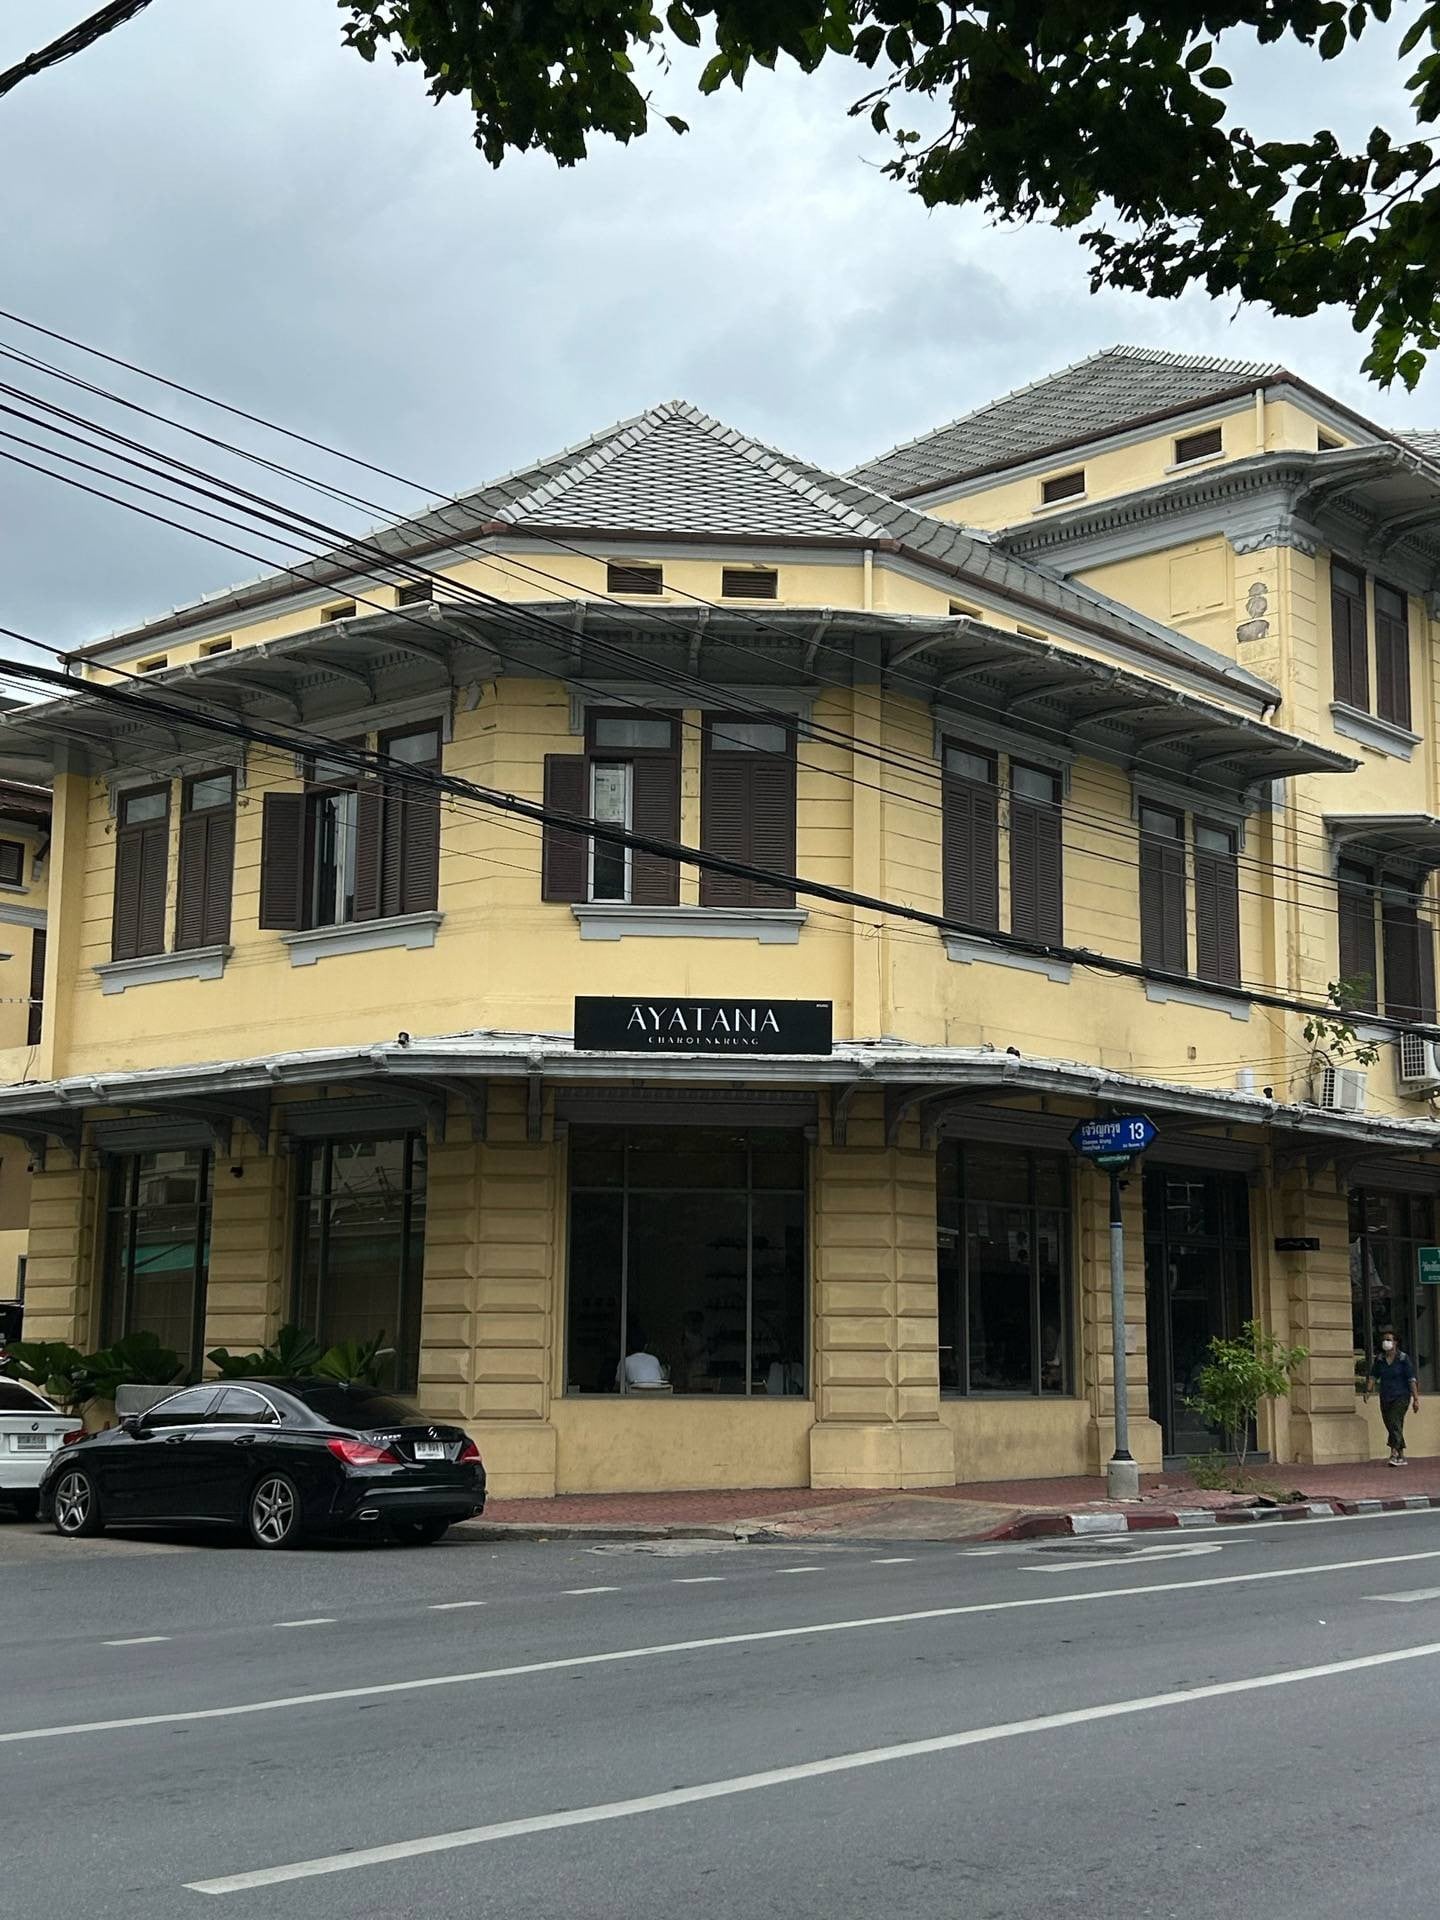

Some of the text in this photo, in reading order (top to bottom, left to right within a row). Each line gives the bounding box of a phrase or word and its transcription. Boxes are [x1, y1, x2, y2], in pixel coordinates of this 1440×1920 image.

[626, 1004, 780, 1032] ĀYATANA
[1081, 1122, 1144, 1140] เจริญกรุง 13
